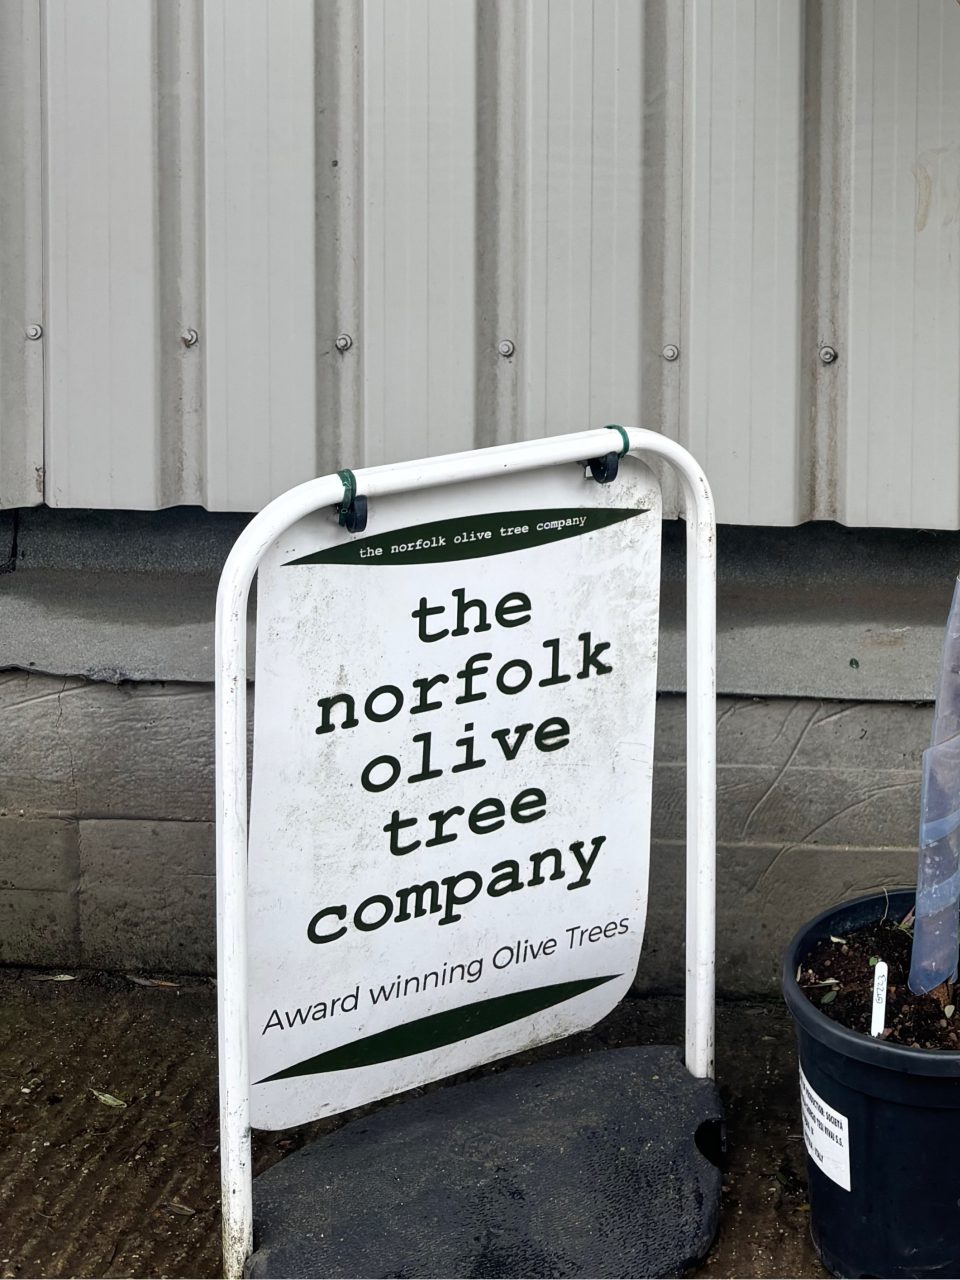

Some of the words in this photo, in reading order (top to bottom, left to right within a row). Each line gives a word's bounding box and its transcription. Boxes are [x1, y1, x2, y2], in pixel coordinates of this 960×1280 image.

[359, 546, 383, 558] the
[391, 536, 447, 554] norfolk
[454, 530, 492, 544] olive
[499, 525, 529, 537] tree
[536, 516, 587, 532] company
[411, 587, 532, 643] the
[315, 631, 613, 735] norfolk
[360, 716, 570, 793] olive
[382, 787, 547, 856] tree
[307, 835, 607, 945] company
[261, 985, 360, 1036] Award
[369, 958, 484, 1005] winning
[492, 938, 557, 970] Olive
[565, 917, 630, 951] Trees
